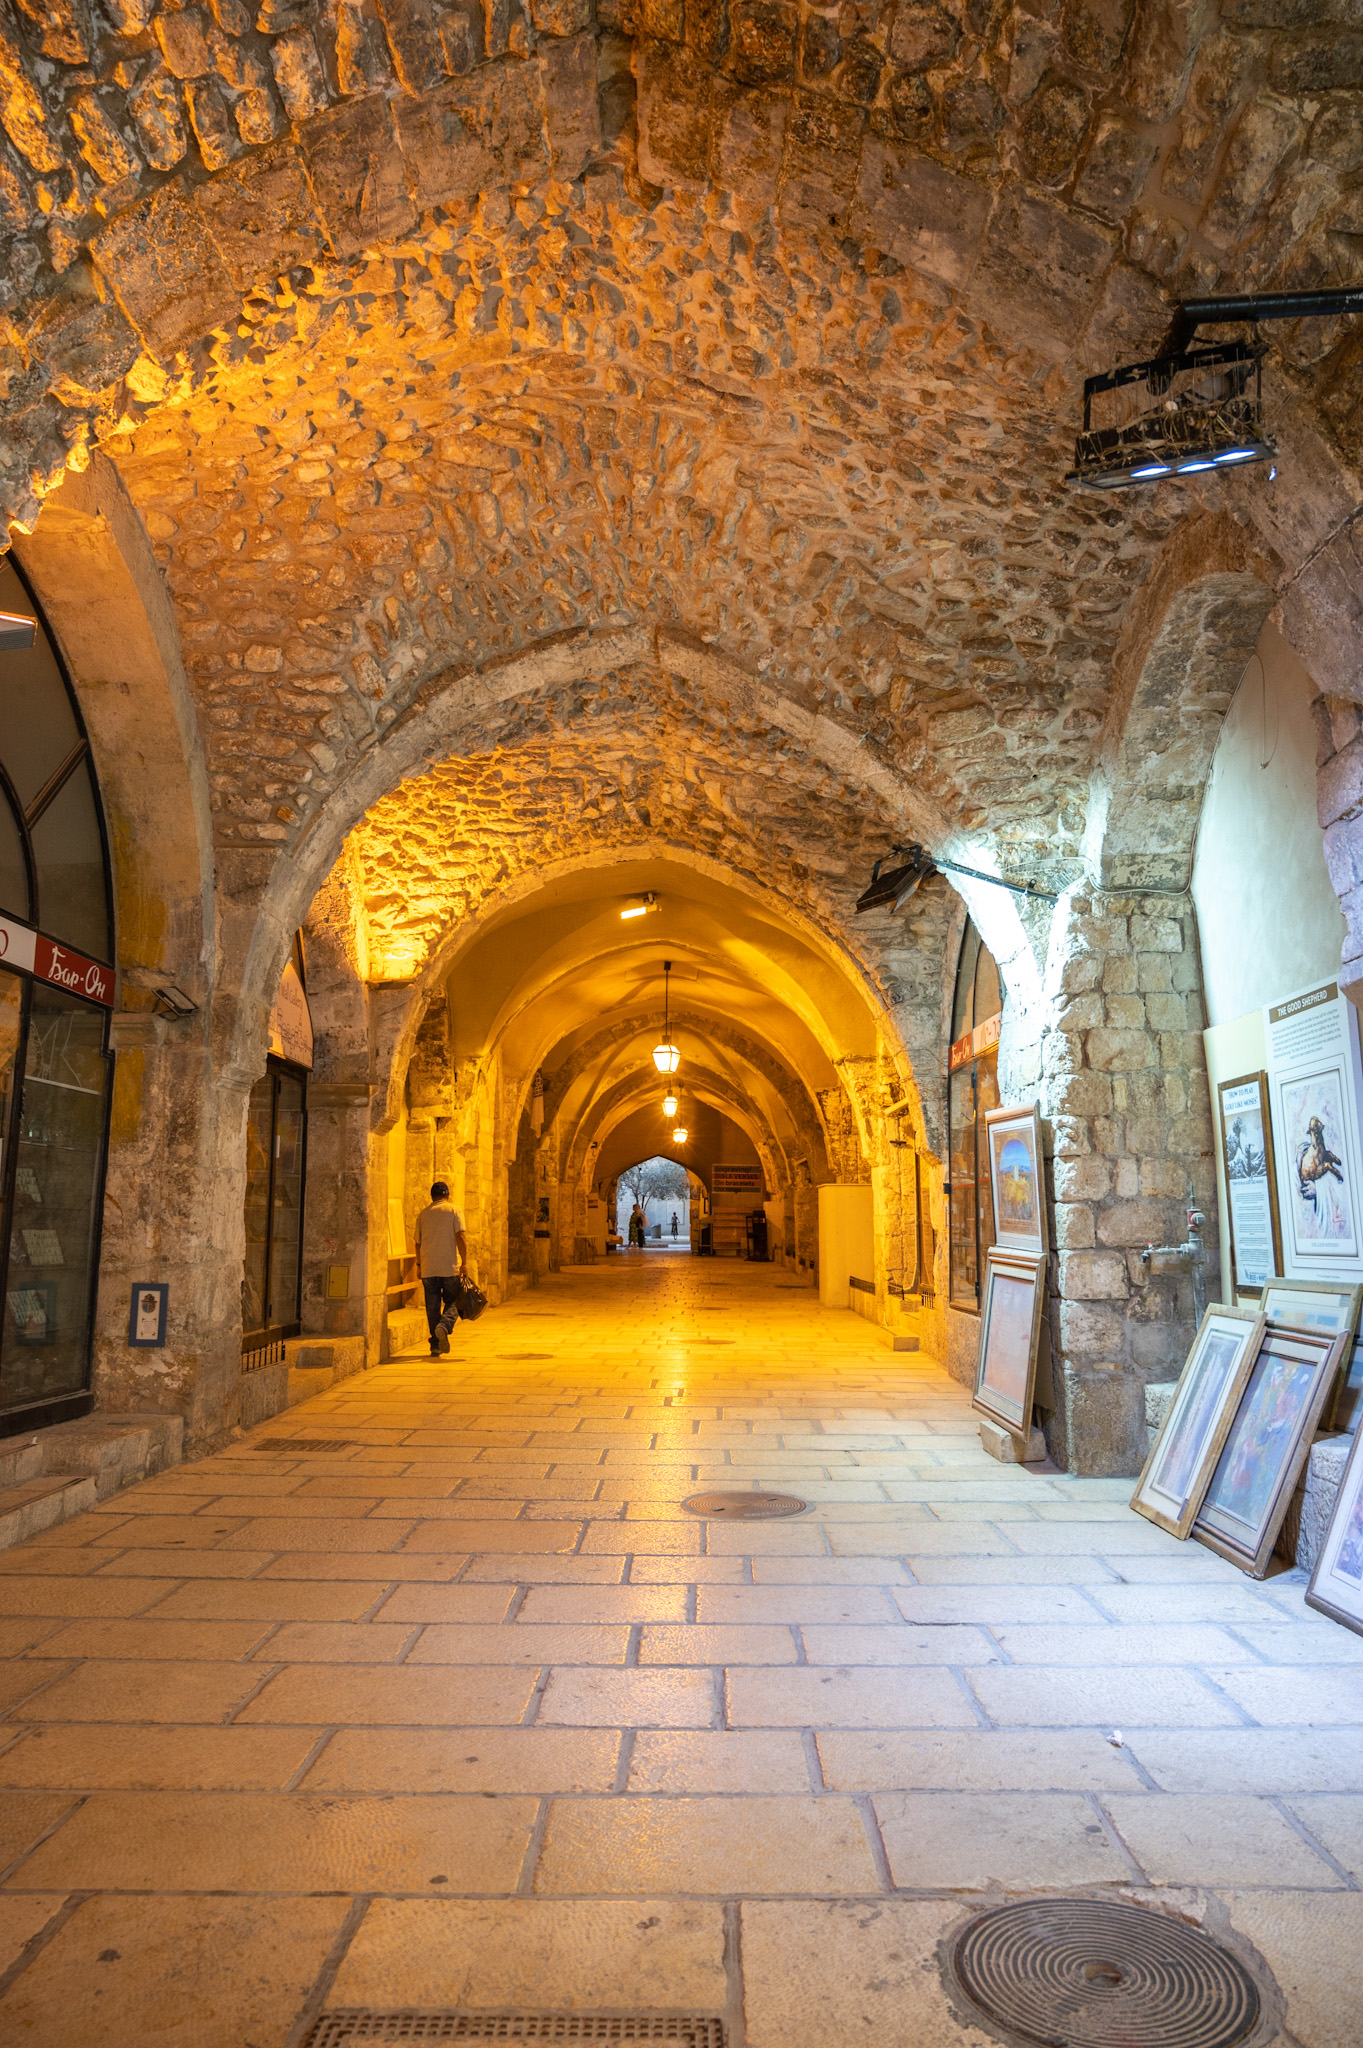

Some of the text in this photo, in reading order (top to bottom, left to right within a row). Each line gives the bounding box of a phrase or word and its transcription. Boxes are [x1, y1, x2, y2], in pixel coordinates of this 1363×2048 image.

[48, 946, 106, 999] Бар-Он
[1277, 990, 1328, 1017] THE GOOD SHEPHERD
